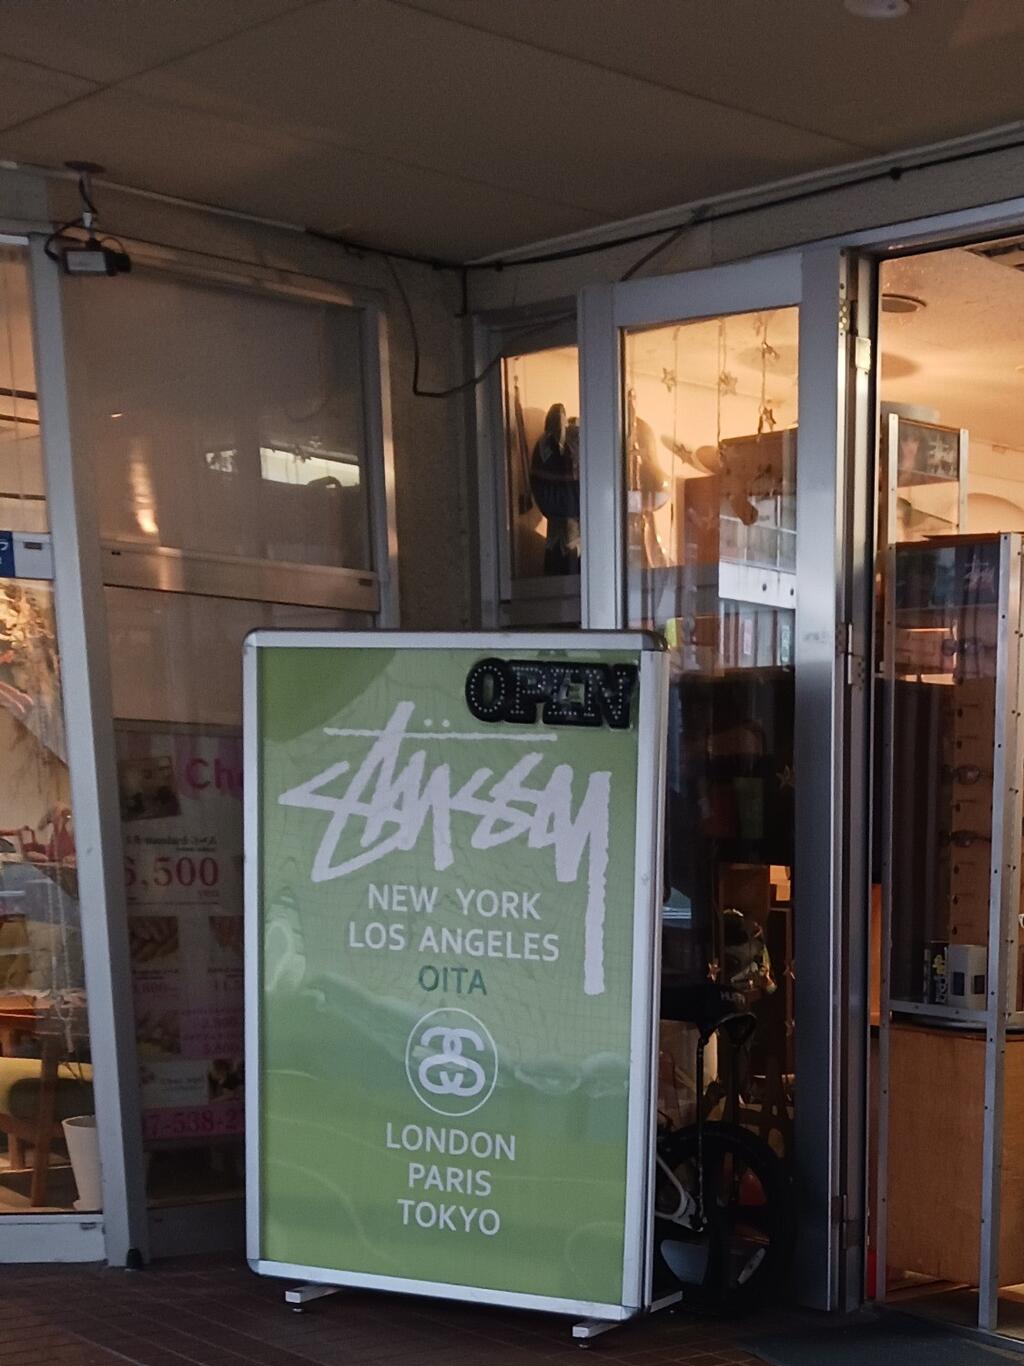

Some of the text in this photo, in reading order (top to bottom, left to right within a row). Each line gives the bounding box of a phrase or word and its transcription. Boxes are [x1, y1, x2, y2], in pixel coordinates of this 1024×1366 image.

[465, 657, 639, 730] OPEN
[367, 883, 542, 920] NEW YORK
[349, 921, 560, 962] LOS ANGELES
[417, 965, 487, 996] OITA
[386, 1122, 516, 1160] LONDON
[408, 1162, 492, 1197] PARIS
[397, 1199, 501, 1236] TOKYO
